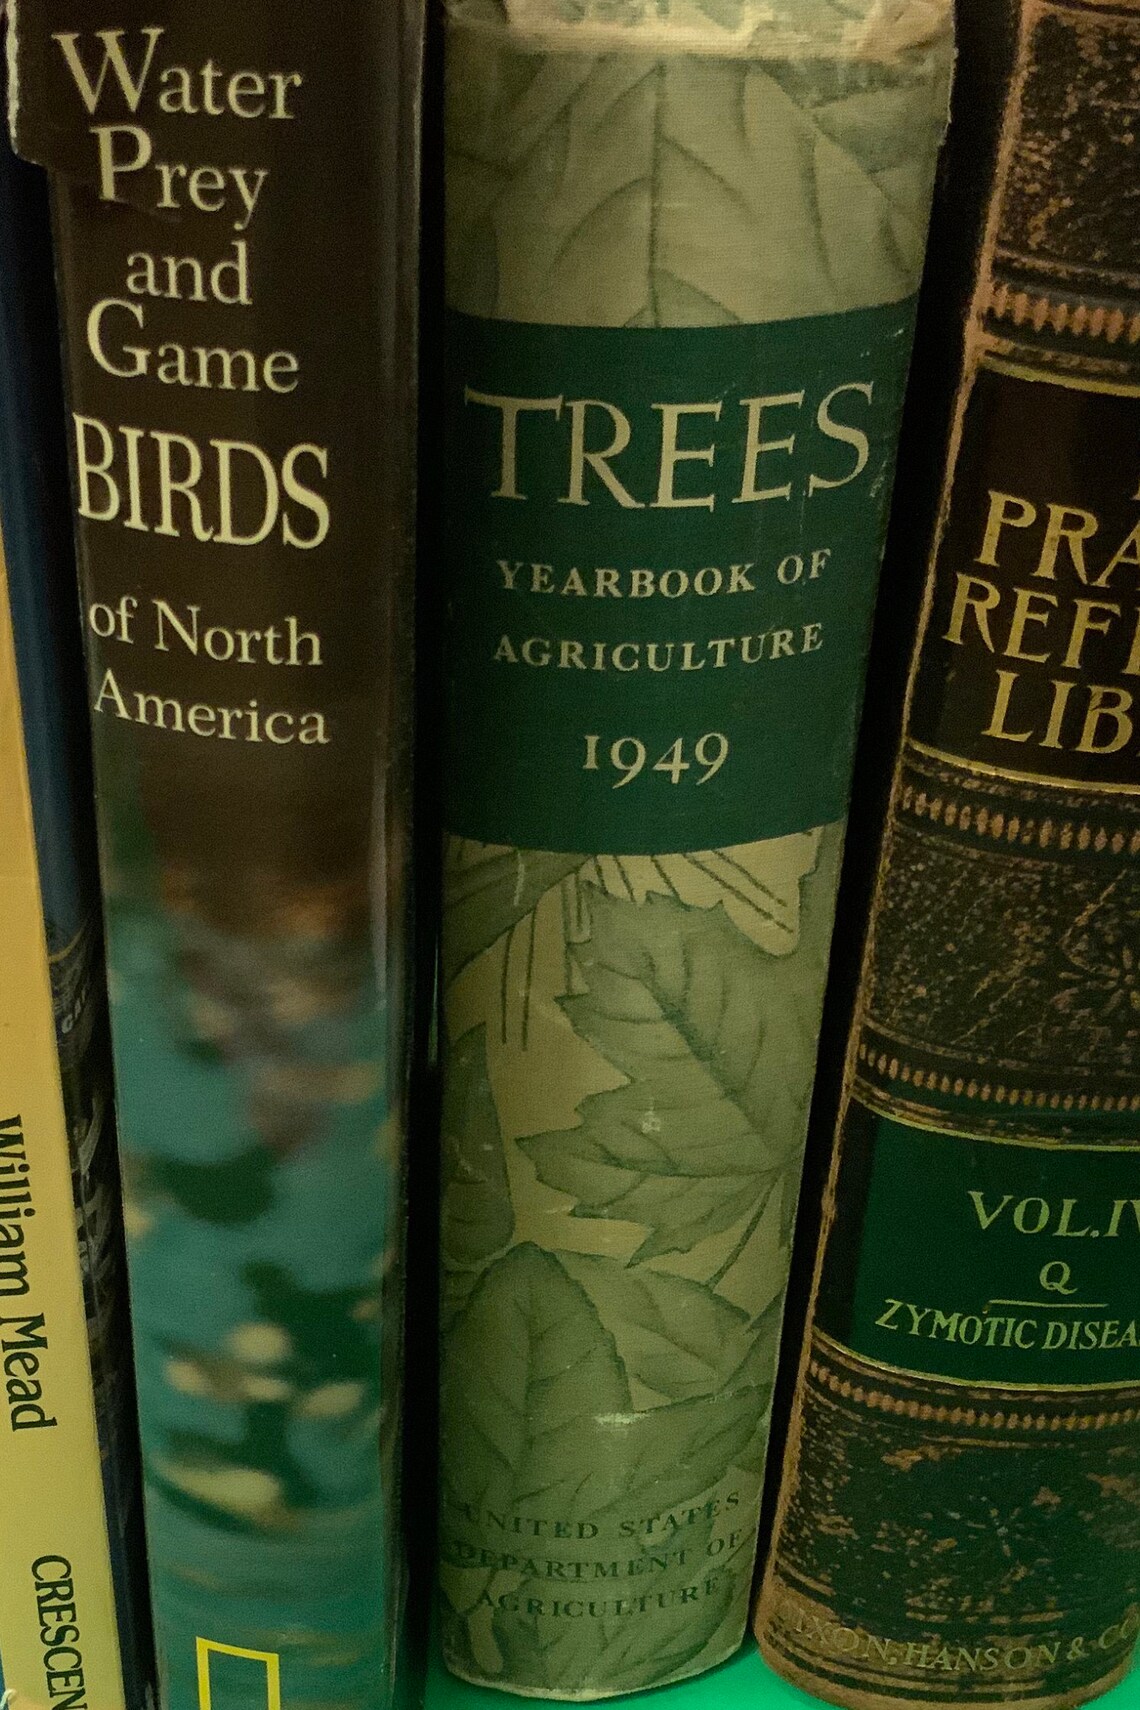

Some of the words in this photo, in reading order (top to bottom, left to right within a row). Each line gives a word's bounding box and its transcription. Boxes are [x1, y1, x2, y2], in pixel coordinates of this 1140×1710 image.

[51, 26, 303, 119] Water
[90, 124, 268, 230] Prey
[127, 239, 253, 305] and
[87, 299, 299, 393] Game
[464, 381, 874, 512] TREES
[72, 412, 330, 549] BIRDS
[496, 560, 756, 599] YEARBOOK
[777, 549, 831, 585] OF
[89, 596, 138, 644] of
[152, 600, 323, 665] North
[494, 623, 823, 671] AGRICULTURE
[94, 668, 330, 744] America
[981, 669, 1140, 754] LIB
[582, 732, 729, 789] 1949
[1039, 1261, 1077, 1294] Q
[875, 1299, 1037, 1349] ZYMOTIC
[1042, 1320, 1140, 1350] DISEA
[0, 1314, 58, 1432] Mead
[454, 1501, 598, 1539] UNITED
[619, 1491, 740, 1537] STATES
[456, 1541, 693, 1578] DEPARTMENT
[707, 1528, 742, 1556] OF
[476, 1576, 720, 1617] AGRICULTURE
[31, 1555, 87, 1710] CRESCEN
[1067, 1636, 1089, 1661] &
